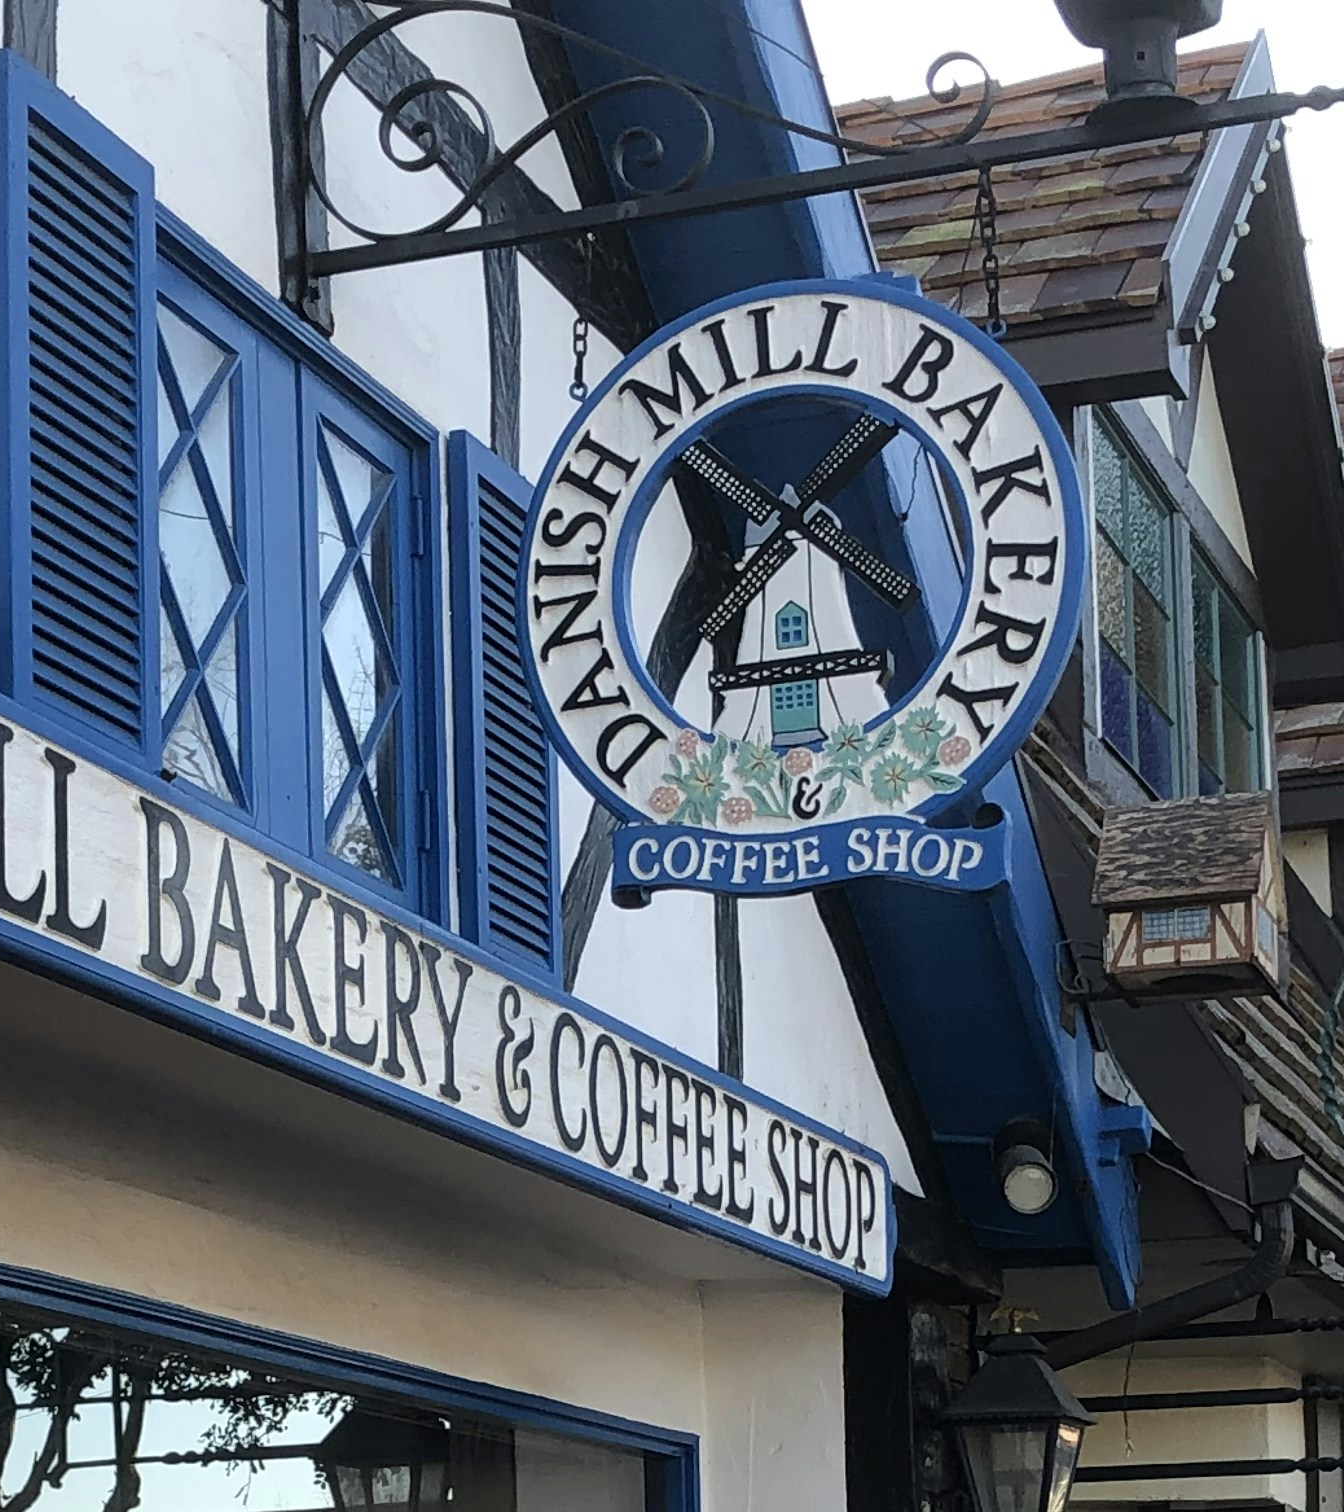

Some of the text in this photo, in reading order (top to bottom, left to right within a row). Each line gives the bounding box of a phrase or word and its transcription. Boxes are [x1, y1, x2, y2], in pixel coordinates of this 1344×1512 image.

[533, 299, 1061, 789] DANISH MILL BAKERY
[627, 825, 984, 886] COFFEE SHOP
[790, 775, 822, 820] &
[138, 796, 473, 1104] BAKERY
[495, 985, 535, 1128] &
[549, 1011, 754, 1224] COFFEE
[766, 1119, 880, 1271] SHOP
